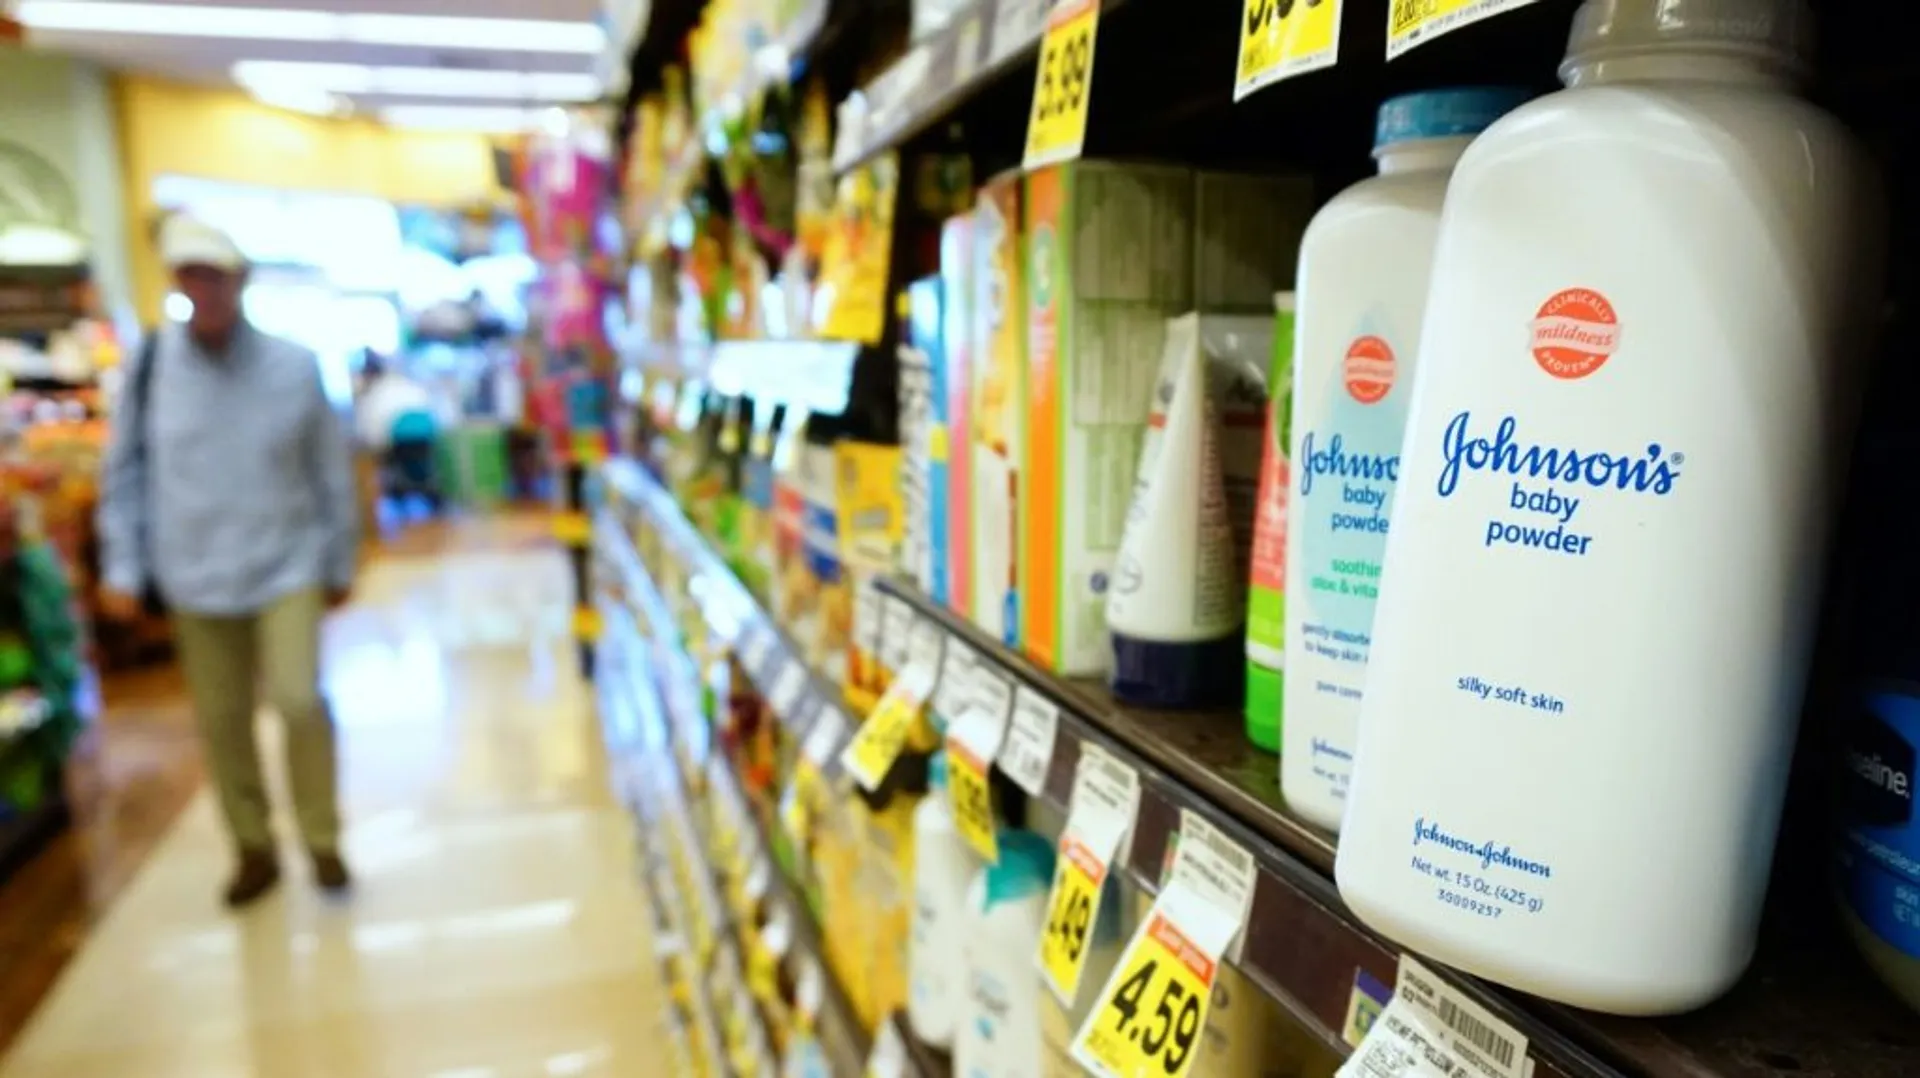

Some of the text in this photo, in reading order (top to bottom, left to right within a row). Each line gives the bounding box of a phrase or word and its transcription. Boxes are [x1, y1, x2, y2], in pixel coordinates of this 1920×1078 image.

[1535, 323, 1614, 346] mildness
[1343, 482, 1386, 511] baby
[1511, 482, 1579, 523] baby
[1486, 520, 1593, 556] powder
[1457, 677, 1564, 714] silky soft skin
[1411, 856, 1432, 876] Net
[1456, 872, 1471, 889] 15
[1495, 885, 1526, 906] (425
[1529, 899, 1544, 913] g)
[1111, 958, 1200, 1077] 4.59
